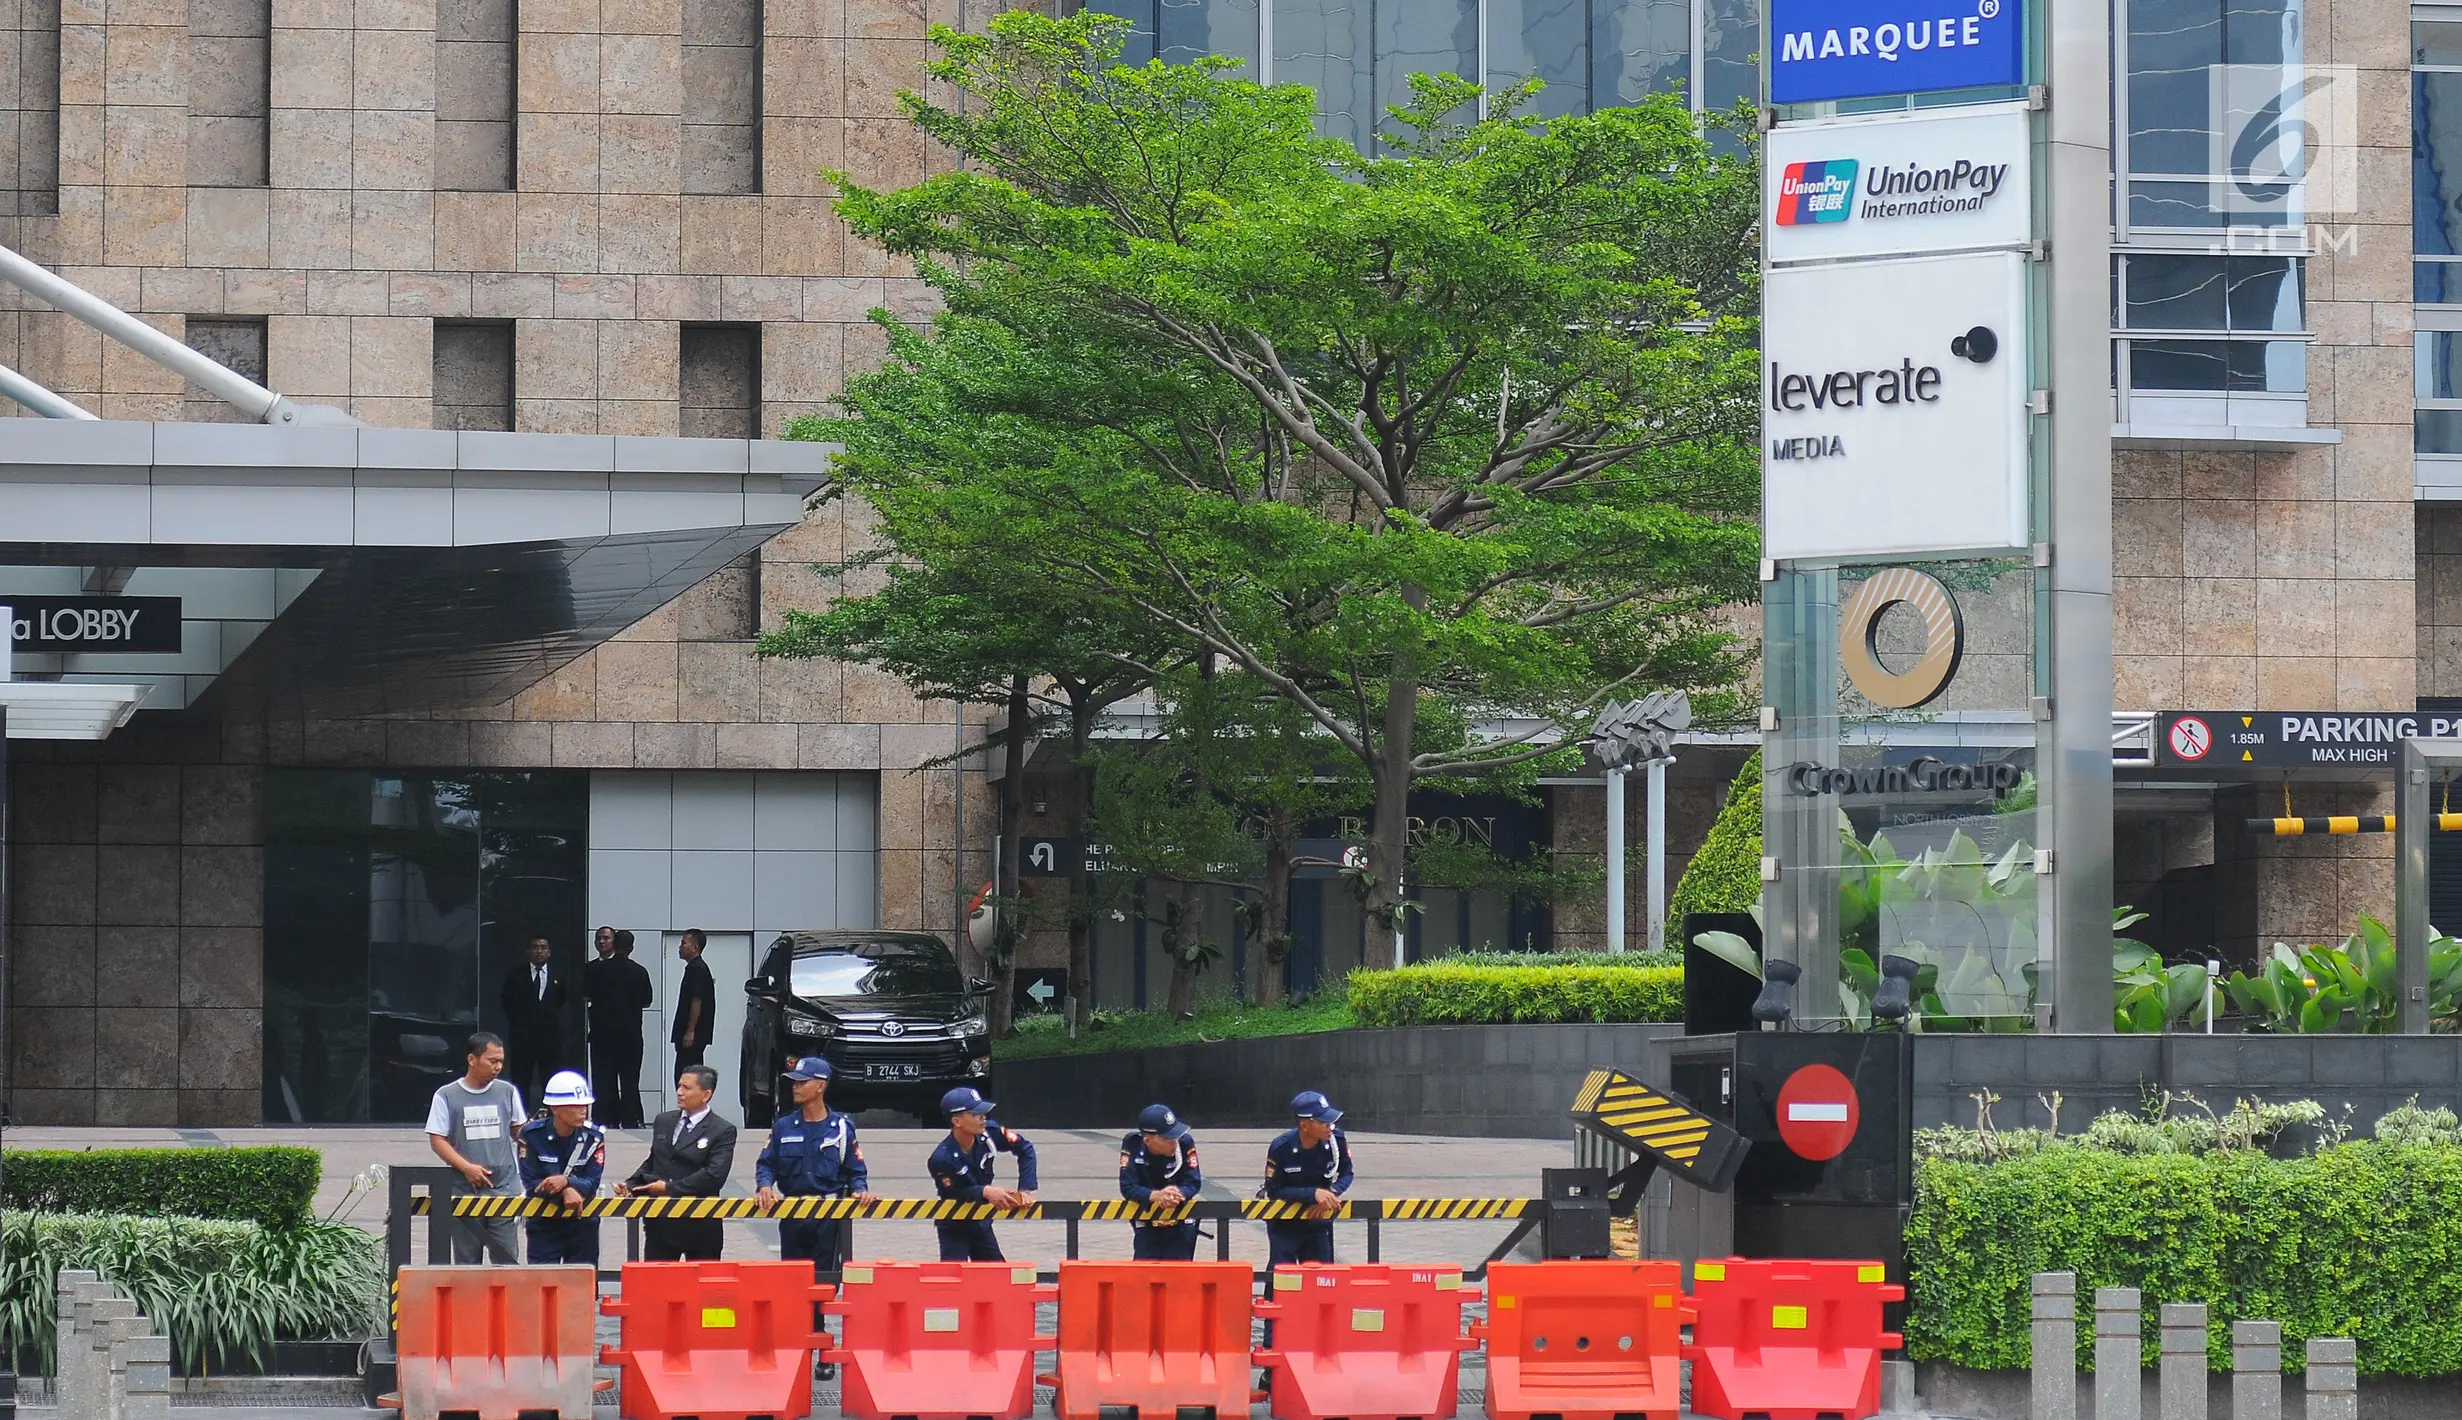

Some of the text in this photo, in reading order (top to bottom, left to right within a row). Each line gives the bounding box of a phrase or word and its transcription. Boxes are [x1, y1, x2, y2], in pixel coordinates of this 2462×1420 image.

[1783, 174, 1851, 197] UnionPay
[1866, 159, 2008, 197] UnionPay
[1807, 194, 1845, 212] 银联
[1860, 195, 1986, 219] International
[1771, 357, 1942, 412] leverate
[1772, 435, 1846, 460] MEDIA
[40, 608, 140, 641] LOBBY
[2230, 733, 2265, 745] 1.85M
[2282, 717, 2418, 743] PARKING
[2312, 749, 2388, 762] MAX HIGH
[1788, 756, 2022, 799] CrownGroup
[866, 1065, 919, 1076] B 2744 SKJ
